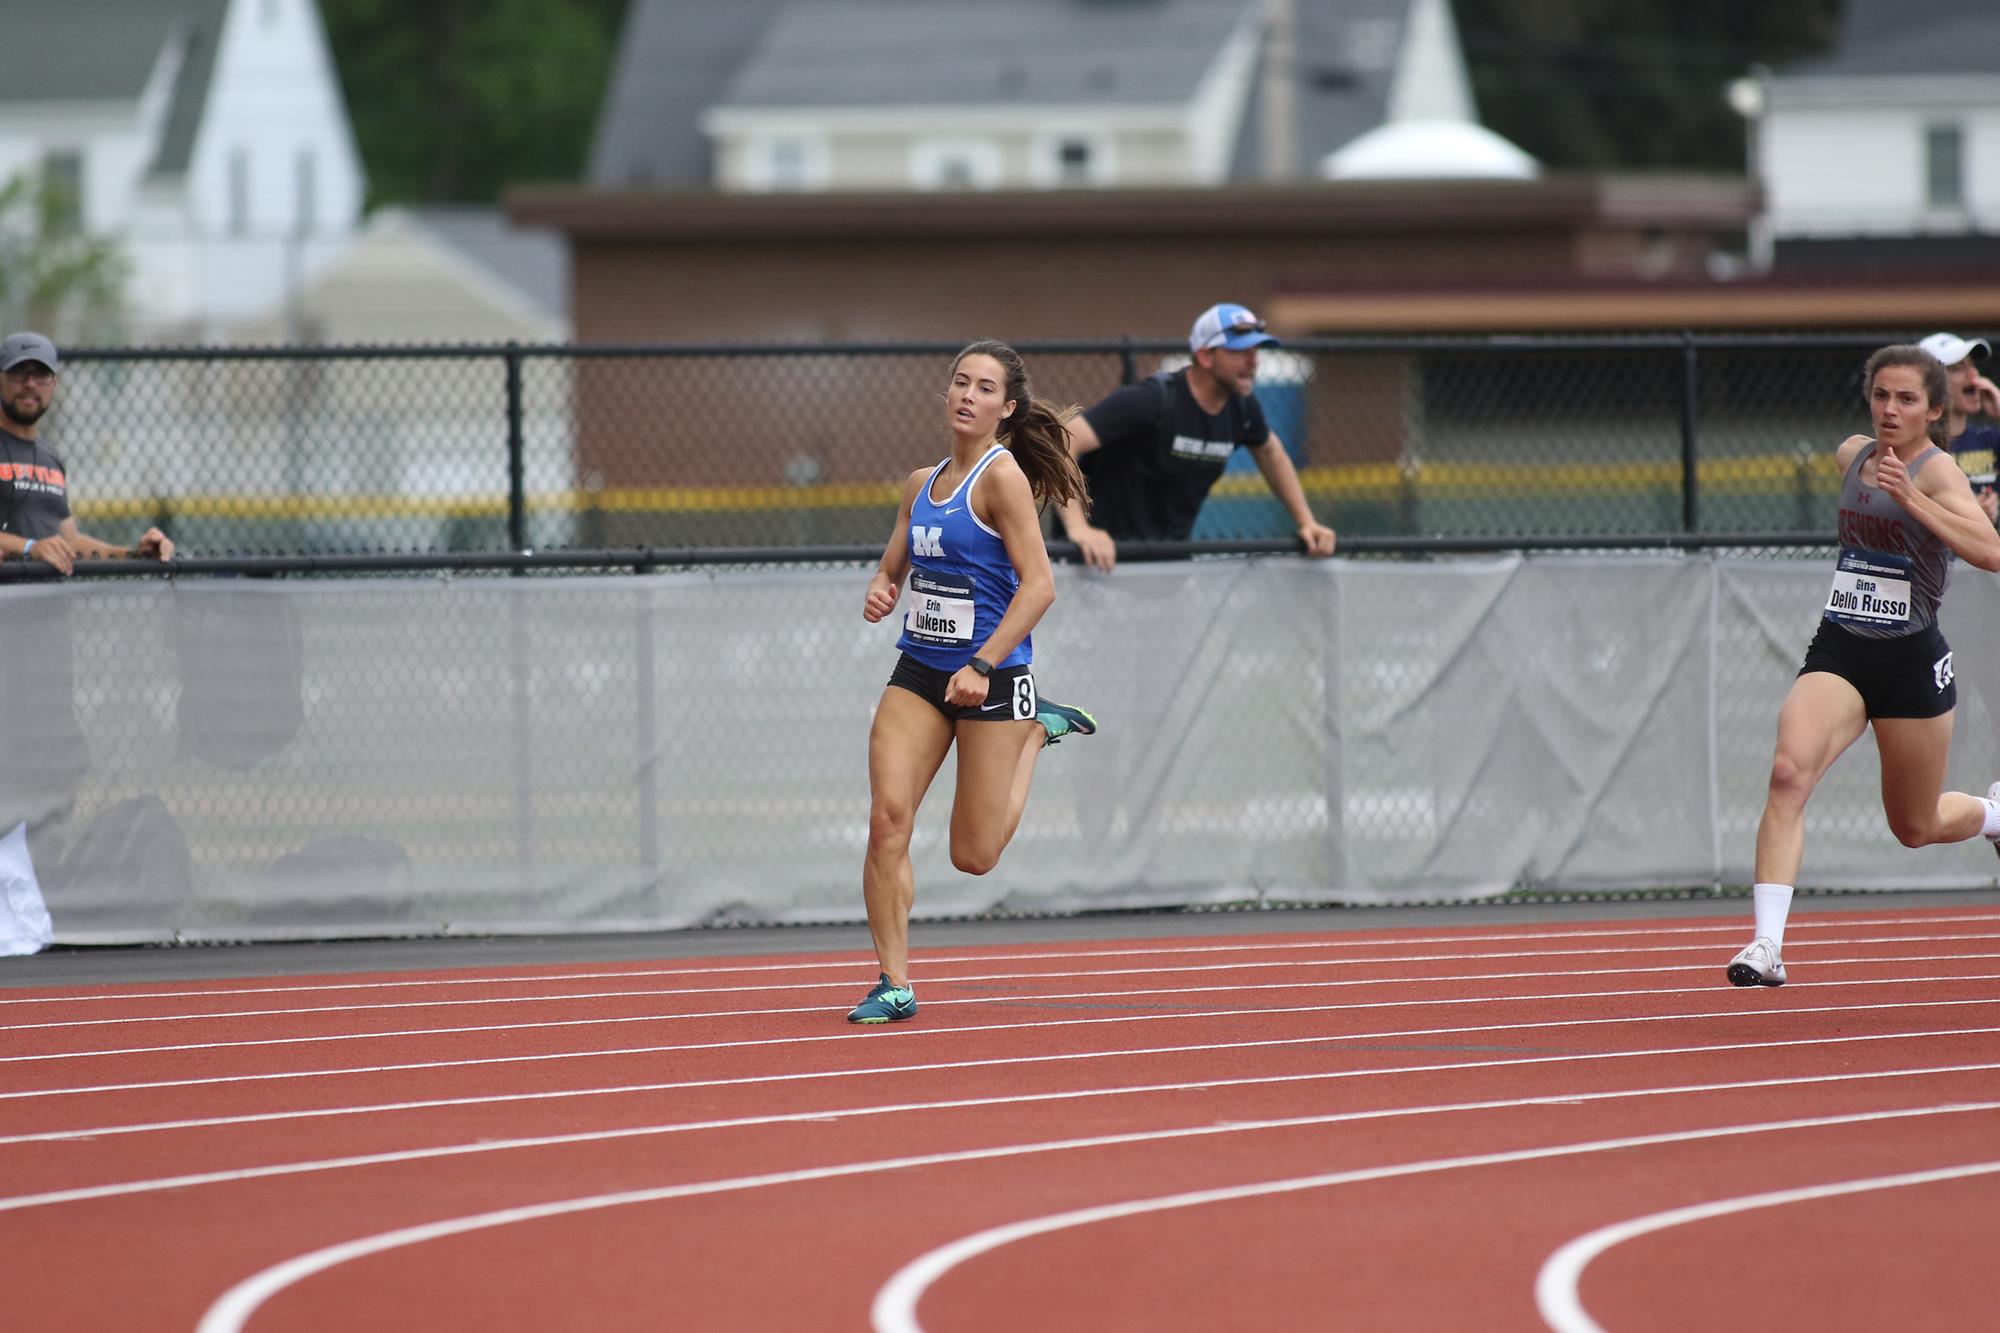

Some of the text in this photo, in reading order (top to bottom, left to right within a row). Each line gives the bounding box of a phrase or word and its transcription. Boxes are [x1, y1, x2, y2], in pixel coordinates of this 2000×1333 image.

[911, 525, 947, 557] M
[1856, 579, 1876, 592] Gina
[926, 599, 941, 612] Erin
[1831, 589, 1907, 616] Dello Russo
[916, 610, 956, 633] Lukens
[1018, 678, 1031, 717] 8
